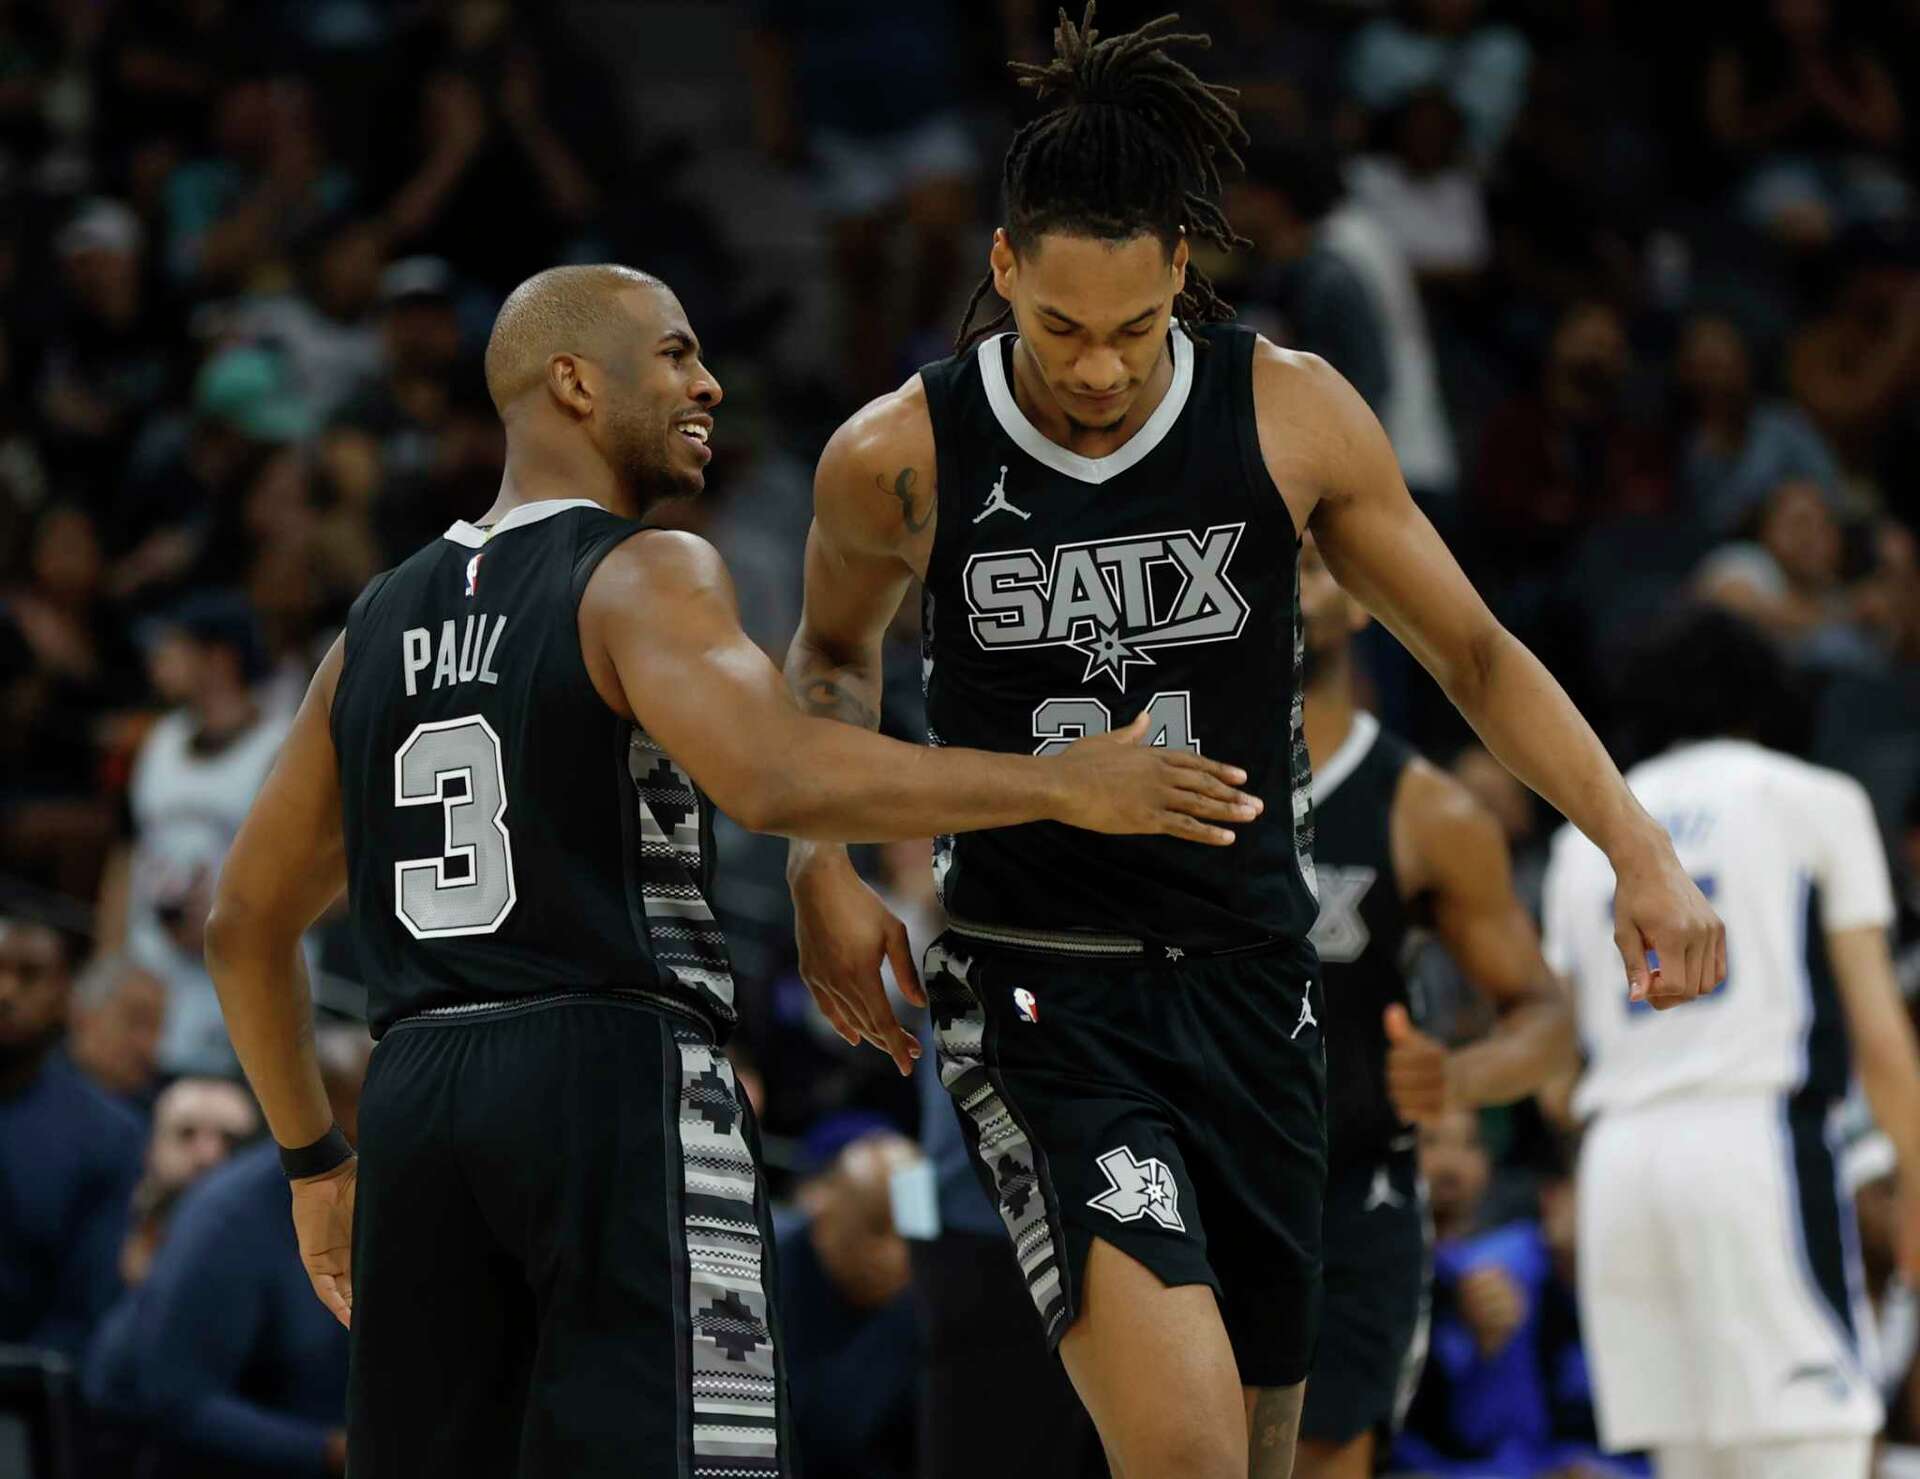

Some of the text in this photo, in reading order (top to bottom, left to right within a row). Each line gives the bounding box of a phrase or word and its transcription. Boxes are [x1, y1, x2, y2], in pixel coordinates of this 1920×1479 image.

[962, 521, 1251, 651] SATX
[402, 612, 508, 697] PAUL
[394, 713, 517, 940] 3
